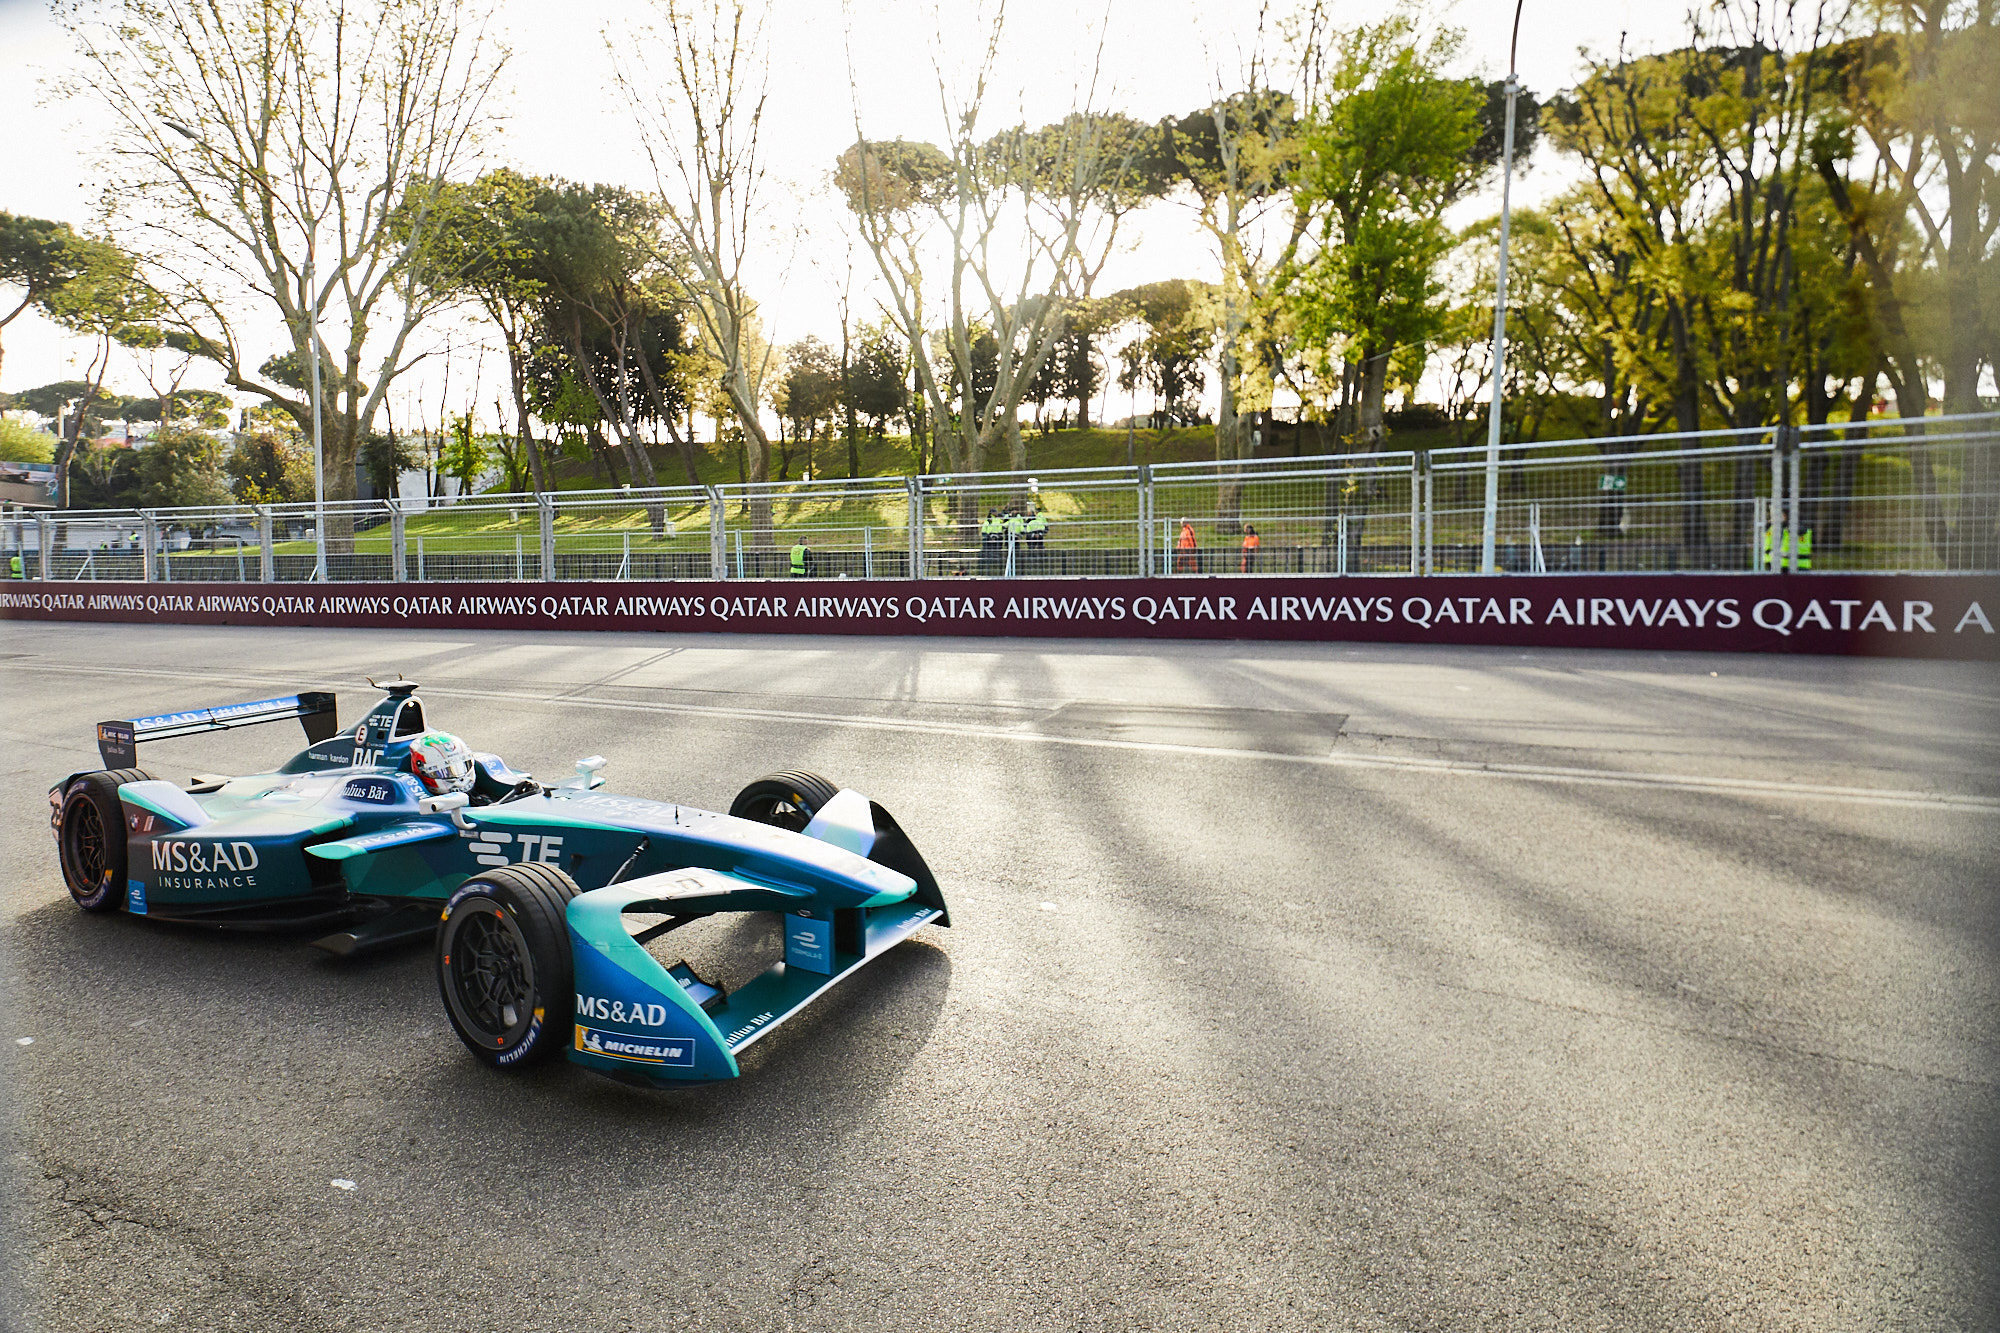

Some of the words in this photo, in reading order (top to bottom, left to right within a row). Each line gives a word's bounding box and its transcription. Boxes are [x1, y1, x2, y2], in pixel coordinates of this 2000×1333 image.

[42, 594, 85, 612] QATAR
[87, 595, 144, 611] AIRWAYS
[146, 595, 194, 614] QATAR
[196, 596, 260, 613] AIRWAYS
[262, 596, 316, 617] QATAR
[319, 596, 390, 615] AIRWAYS
[393, 596, 453, 617] QATAR
[457, 596, 537, 616] AIRWAYS
[540, 596, 609, 620] QATAR
[614, 596, 706, 617] AIRWAYS
[710, 596, 789, 622] QATAR
[793, 597, 900, 619] AIRWAYS
[905, 596, 996, 623] QATAR
[1002, 597, 1126, 620] AIRWAYS
[1132, 597, 1238, 625] QATAR
[1246, 596, 1394, 623] AIRWAYS
[1401, 597, 1534, 629] QATAR
[1545, 598, 1741, 629] AIRWAYS
[1752, 599, 1937, 636] QATAR
[380, 714, 394, 727] TE
[367, 785, 389, 800] Bär
[151, 840, 259, 873] MS&AD
[517, 834, 564, 868] TE
[159, 875, 257, 889] INSURANCE
[576, 993, 666, 1027] MS&AD
[500, 1028, 536, 1064] MICHELIN
[604, 1040, 683, 1058] MICHELIN
[725, 1024, 756, 1048] ulius
